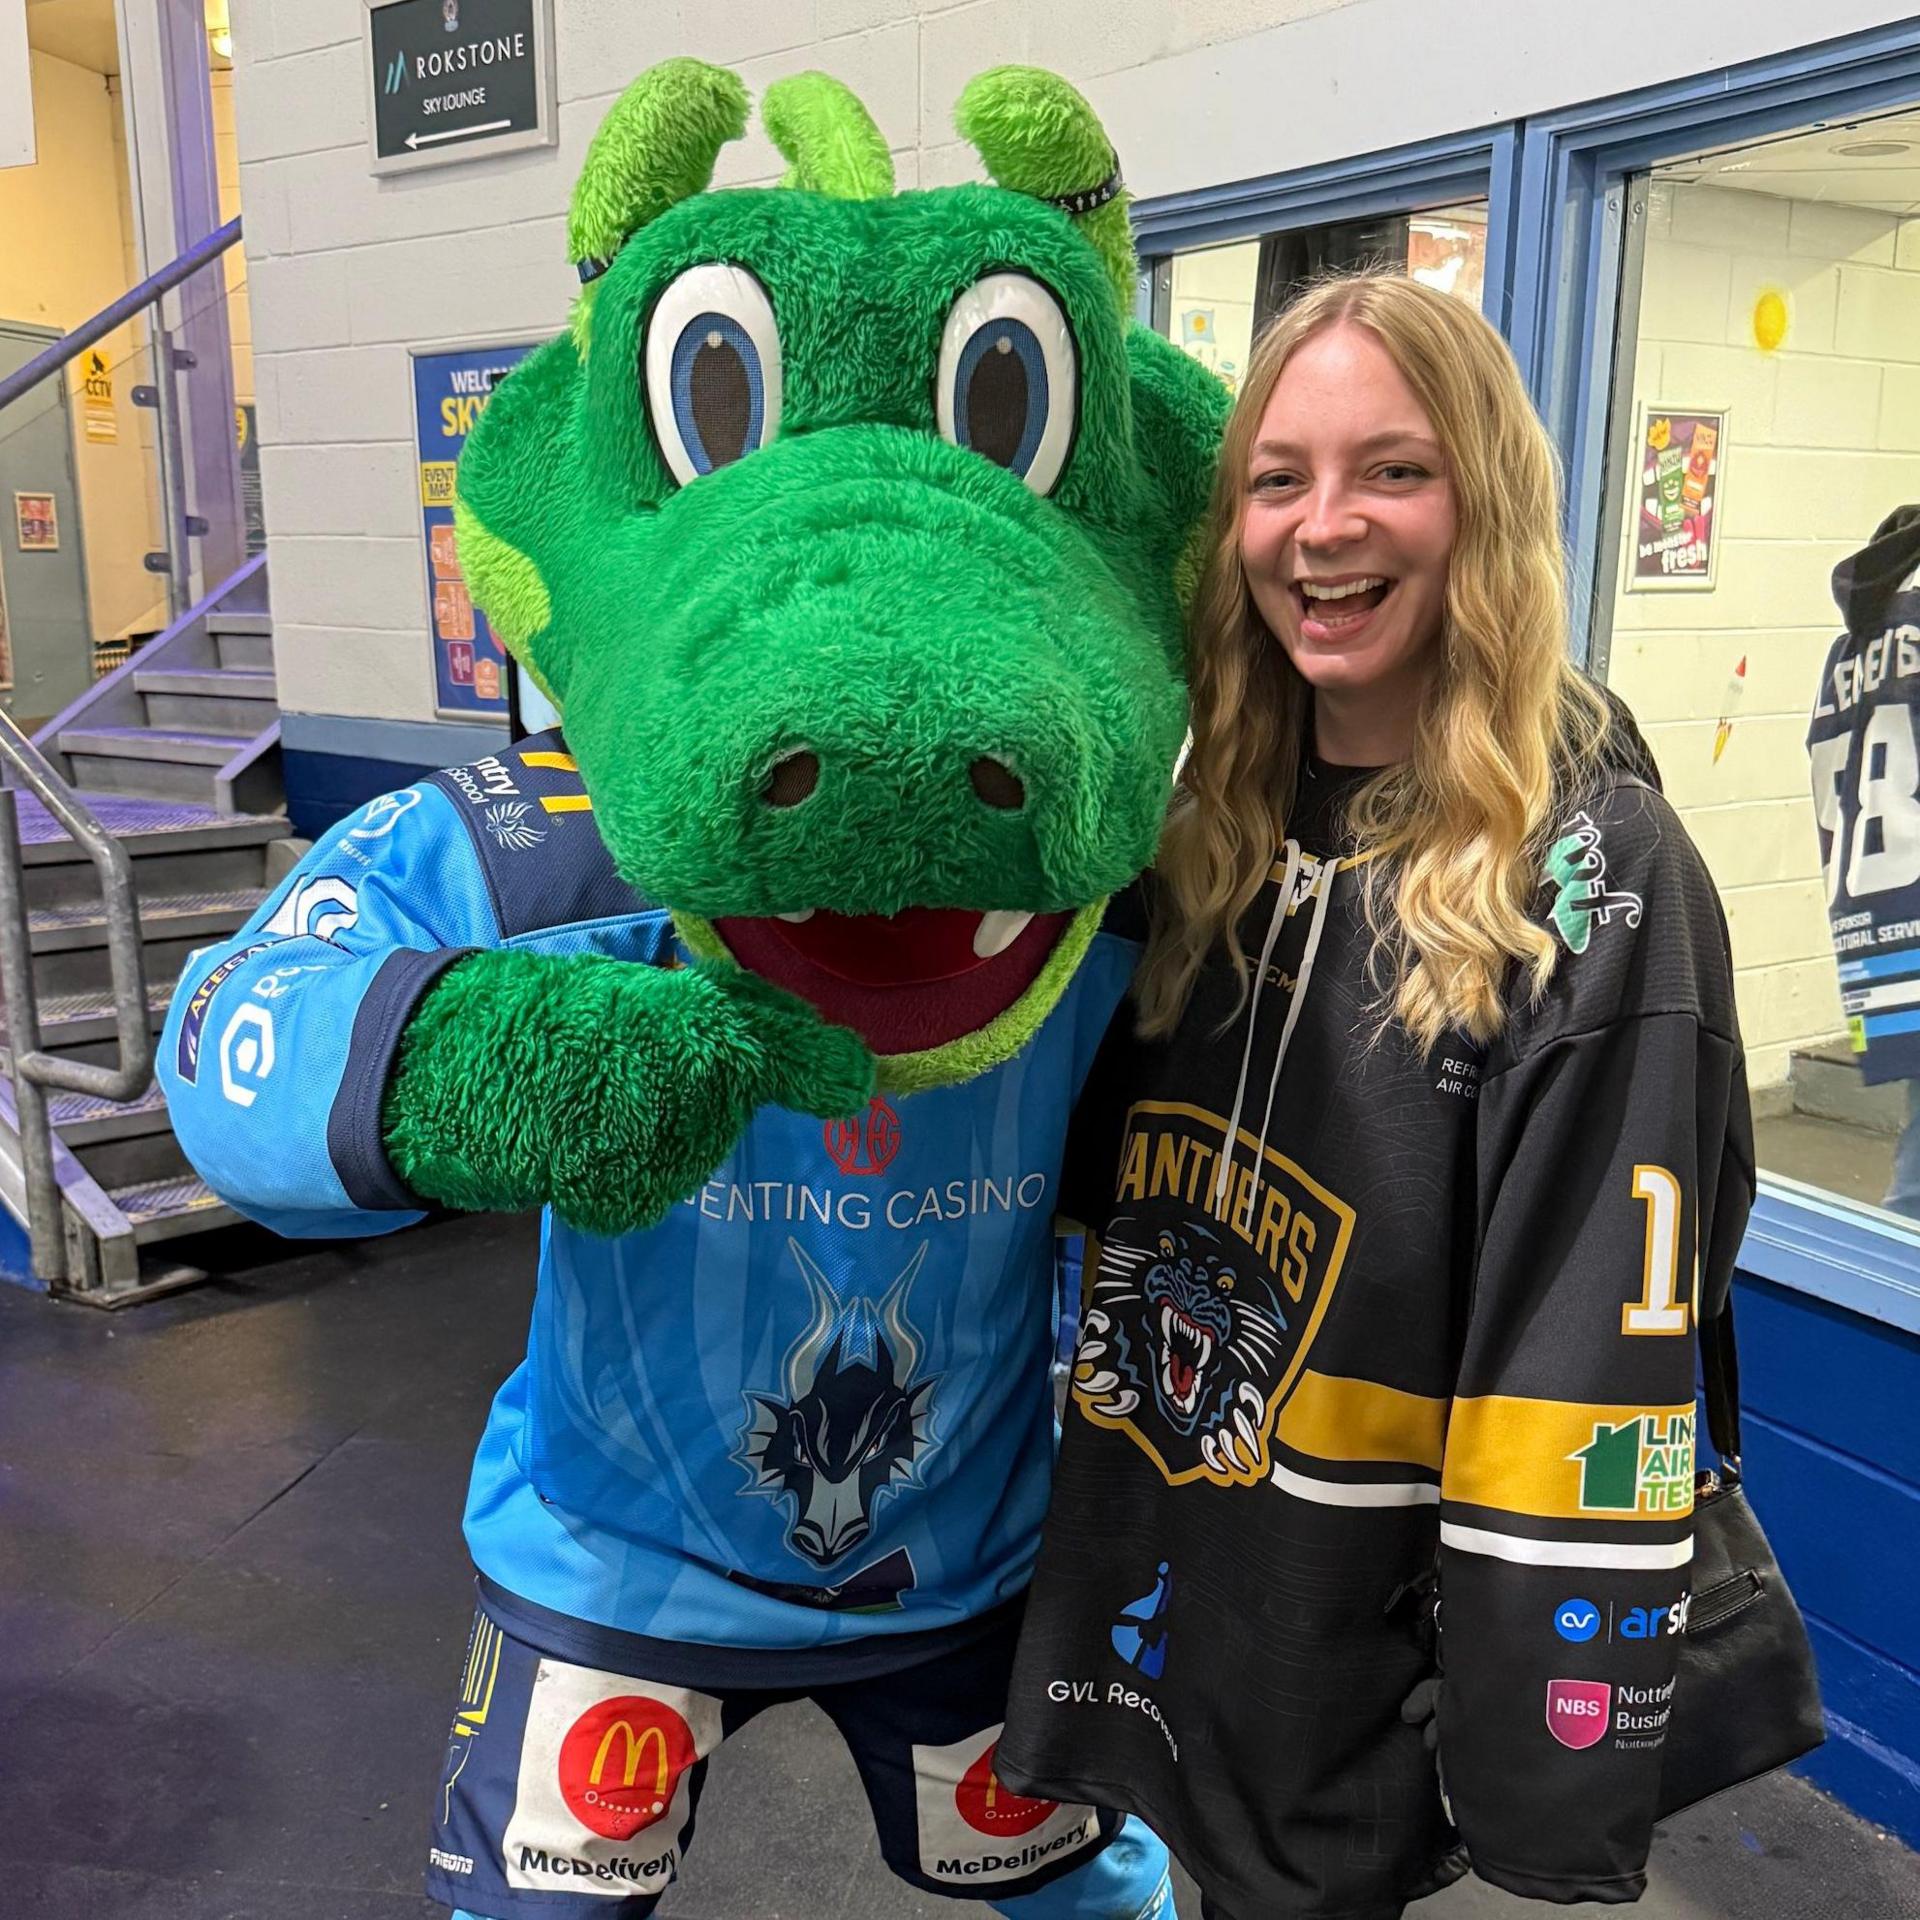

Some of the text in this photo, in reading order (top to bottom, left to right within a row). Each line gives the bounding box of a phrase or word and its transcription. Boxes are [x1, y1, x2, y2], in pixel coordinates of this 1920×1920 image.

[416, 33, 525, 79] ROKSTONE
[423, 87, 486, 115] SKY LOUNGE
[86, 378, 112, 398] CCTV
[424, 467, 456, 483] EVENT
[1661, 539, 1707, 573] fresh
[467, 756, 520, 795] ntry
[1435, 1077, 1463, 1095] AIR
[686, 1172, 1046, 1230] ENTING CASINO
[1115, 1131, 1318, 1304] ANTHERS
[1620, 1163, 1698, 1336] 1
[1642, 1447, 1692, 1477] AIR
[1047, 1681, 1099, 1702] GVL
[1556, 1697, 1600, 1717] NBS
